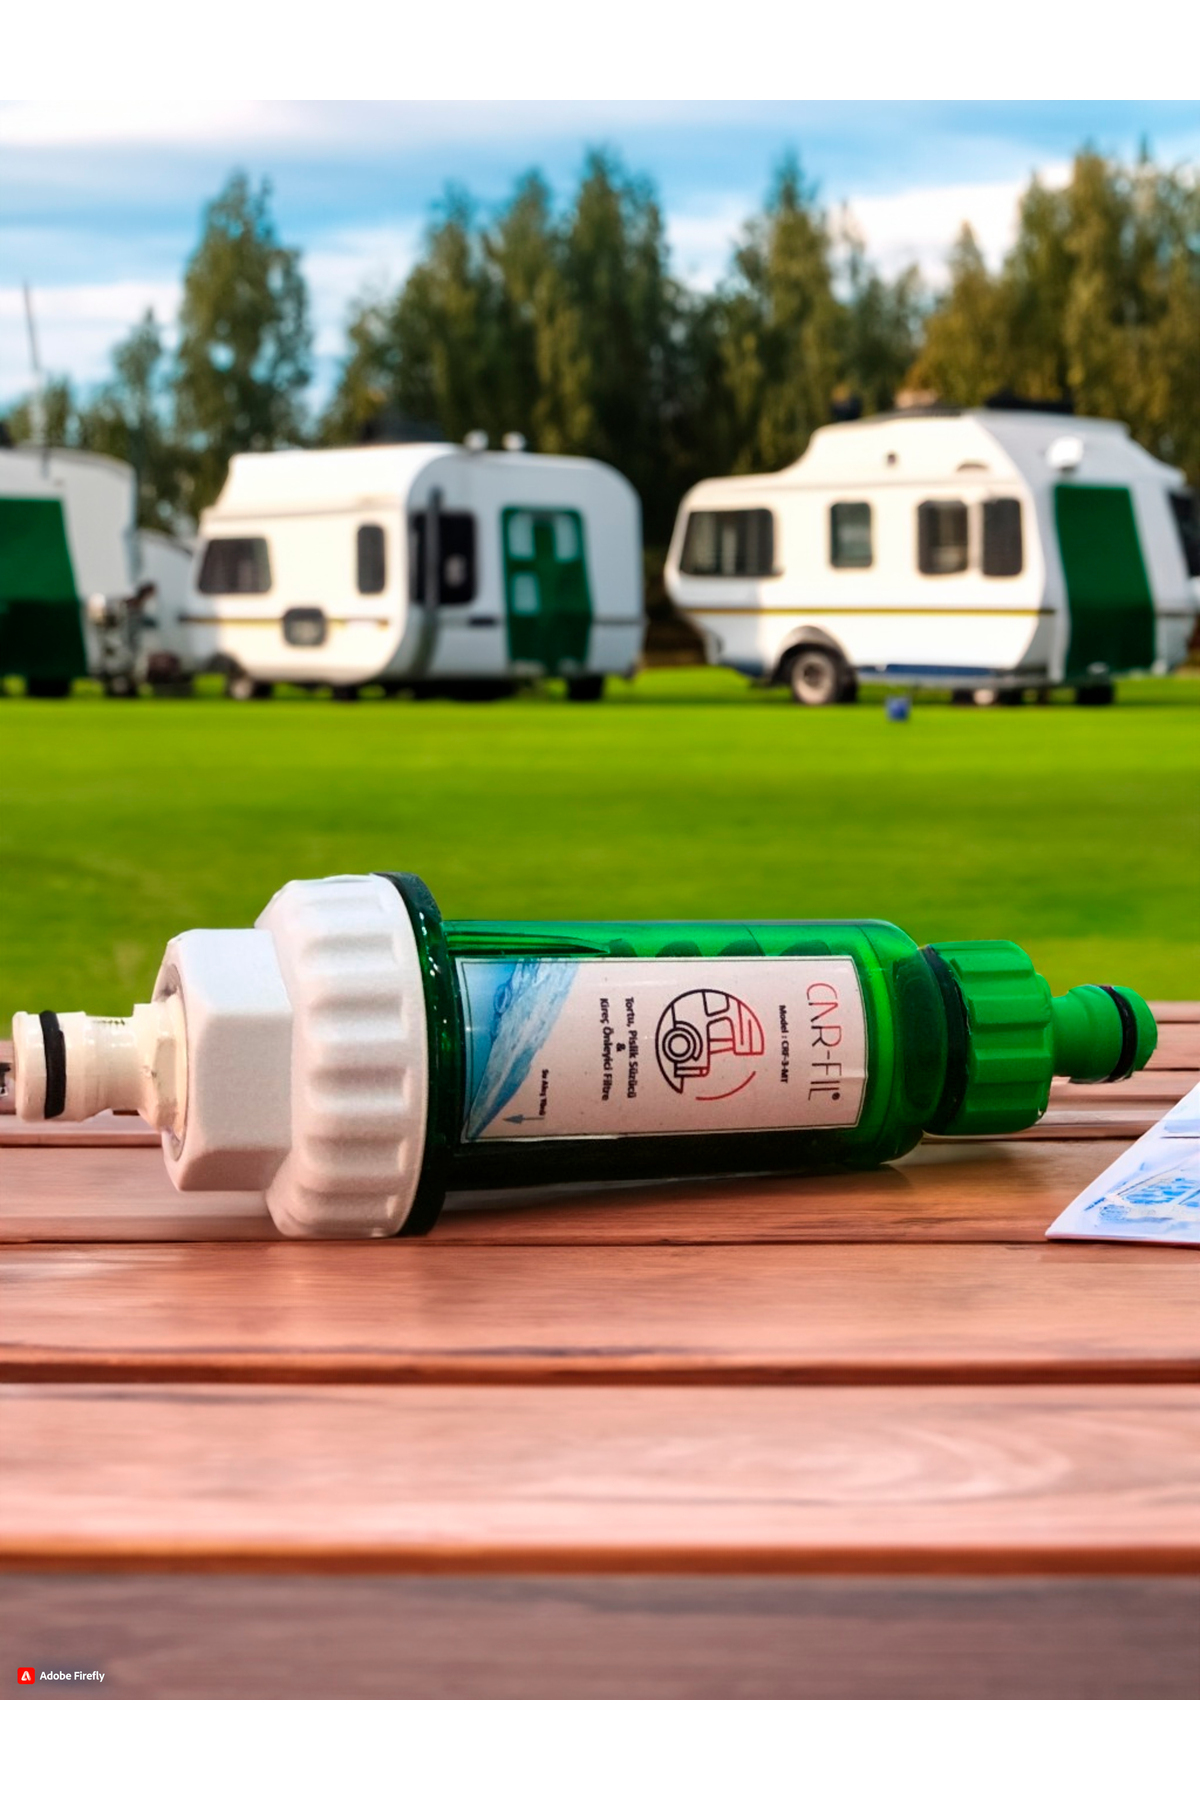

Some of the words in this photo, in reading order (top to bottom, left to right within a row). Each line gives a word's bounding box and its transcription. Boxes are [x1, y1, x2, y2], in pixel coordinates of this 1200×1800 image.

[600, 998, 610, 1024] Kireç
[625, 997, 635, 1027] Tortu,
[779, 1004, 789, 1034] Model
[602, 1026, 614, 1071] Önleyici
[616, 1042, 626, 1052] &
[628, 1030, 639, 1059] Pislik
[780, 1040, 790, 1084] CRF-3-MT
[601, 1073, 613, 1101] Filtre
[627, 1061, 639, 1099] Süzücü
